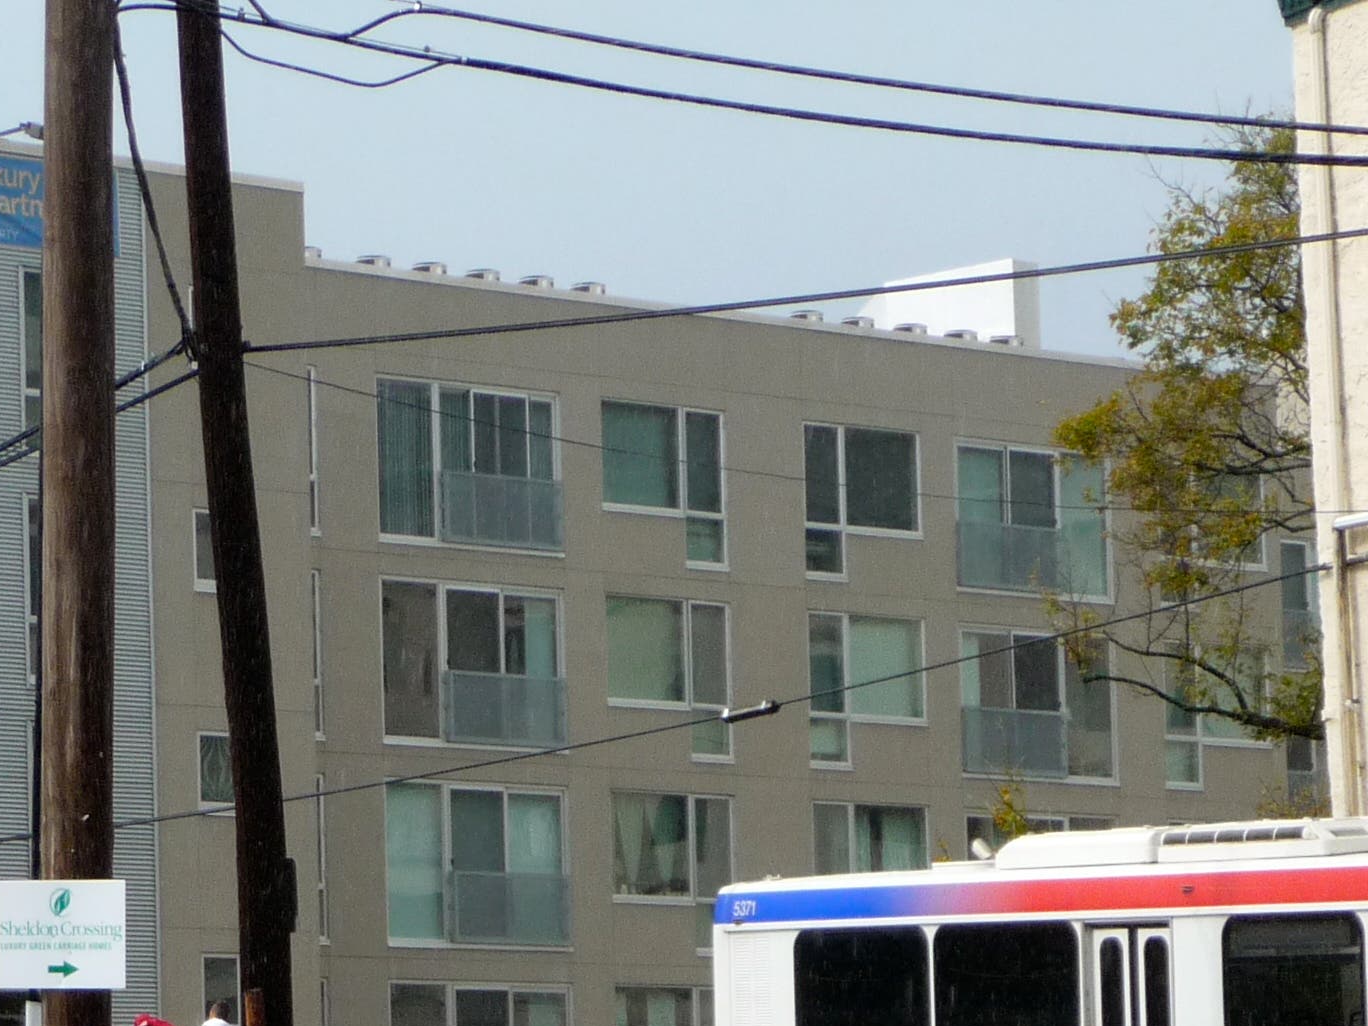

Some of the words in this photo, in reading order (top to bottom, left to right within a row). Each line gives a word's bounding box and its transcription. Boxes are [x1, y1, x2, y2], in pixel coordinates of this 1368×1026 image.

[733, 901, 756, 916] 5371
[0, 920, 58, 938] Sheldon
[61, 921, 122, 941] Crossing
